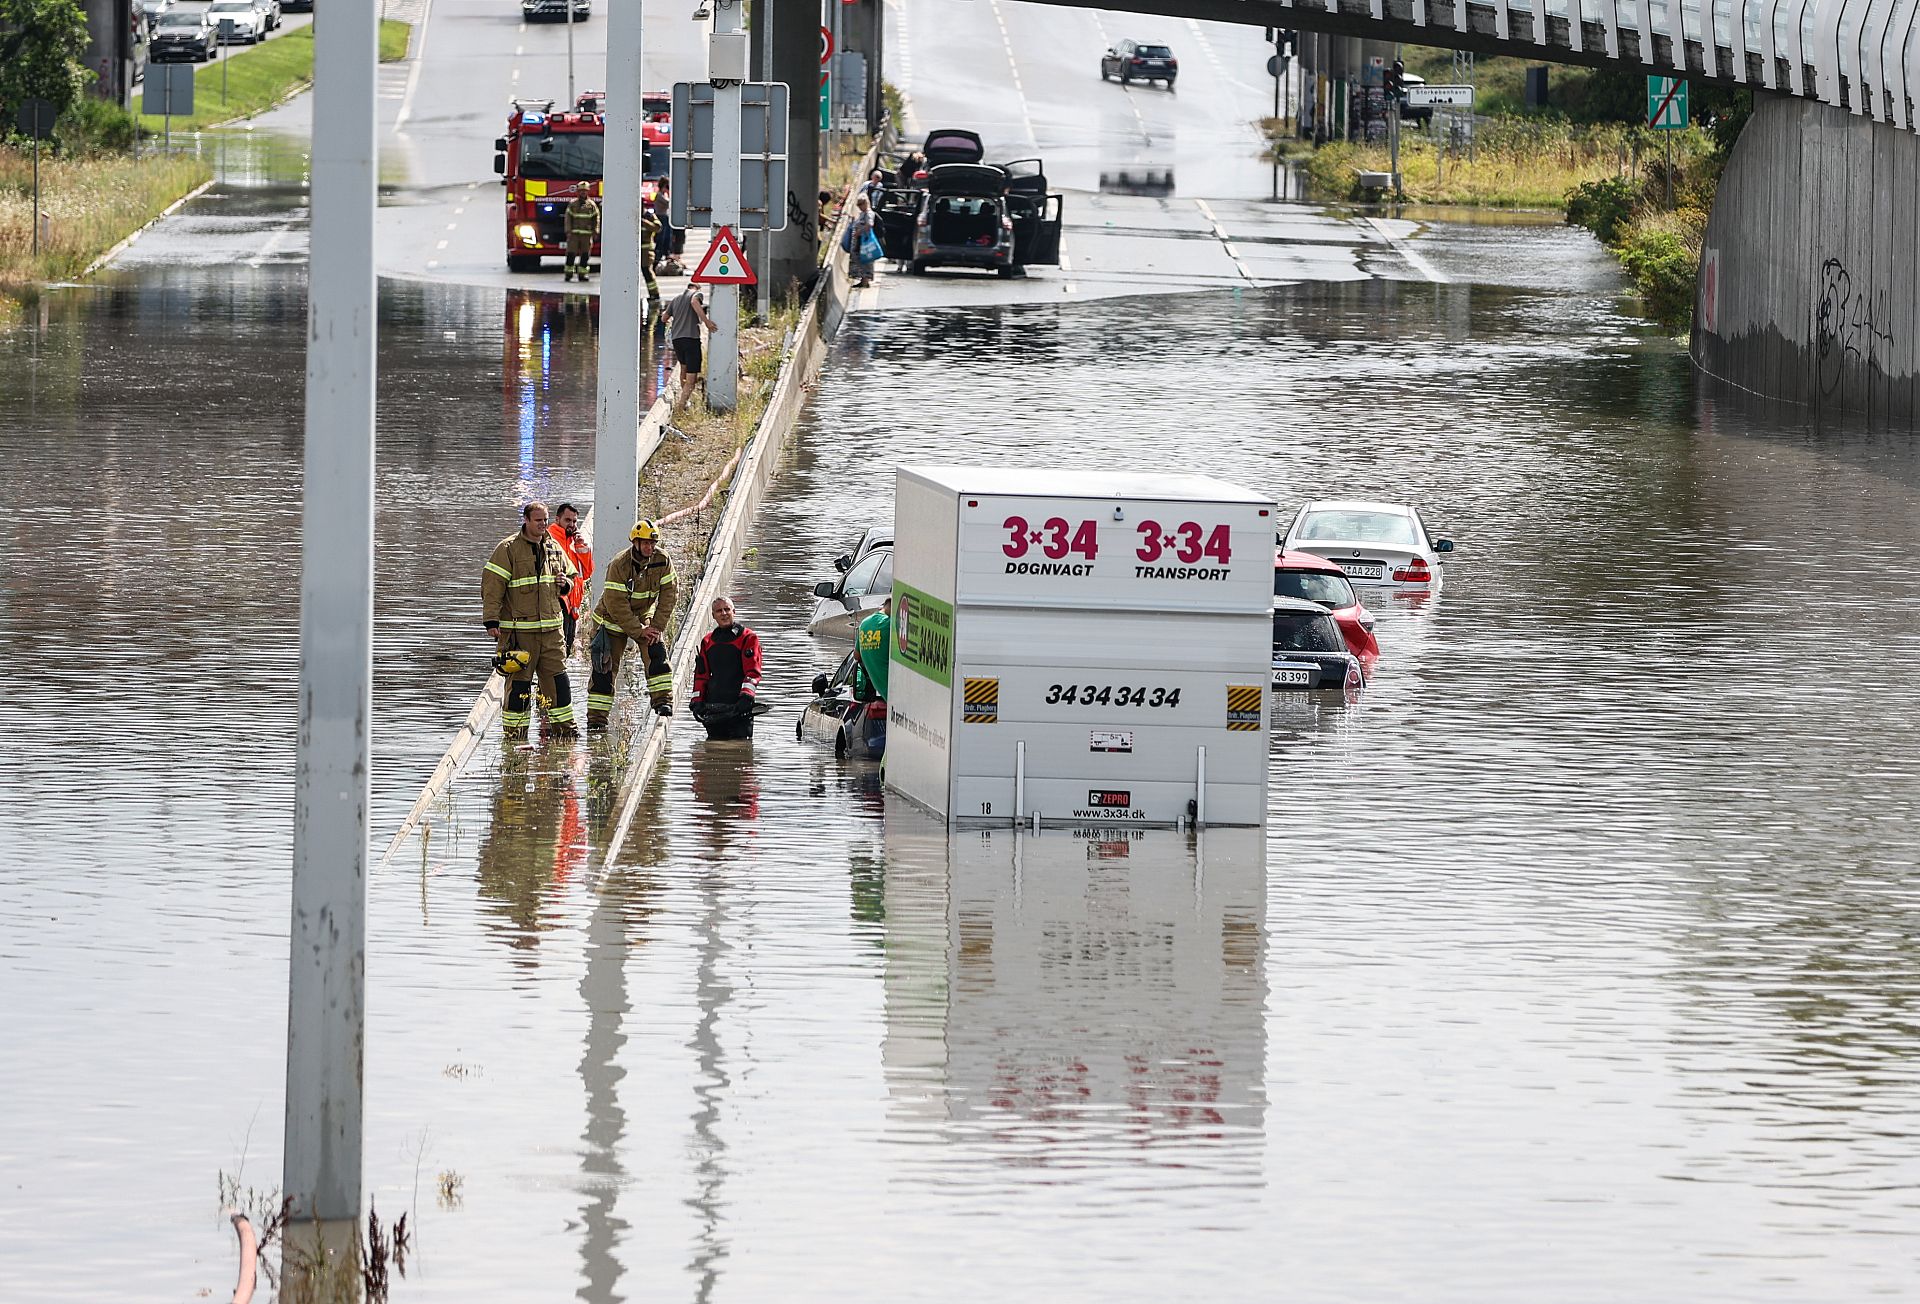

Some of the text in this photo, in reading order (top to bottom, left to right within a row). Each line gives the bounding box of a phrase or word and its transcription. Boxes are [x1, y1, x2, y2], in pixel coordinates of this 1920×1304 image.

[1005, 562, 1095, 577] DØGNVAGT
[1135, 566, 1231, 581] TRANSPORT
[1364, 567, 1381, 577] 228
[1274, 671, 1308, 682] 48 399
[1102, 793, 1129, 805] ZEPRO
[981, 802, 992, 815] 18
[1073, 808, 1146, 820] www.3x34.dk
